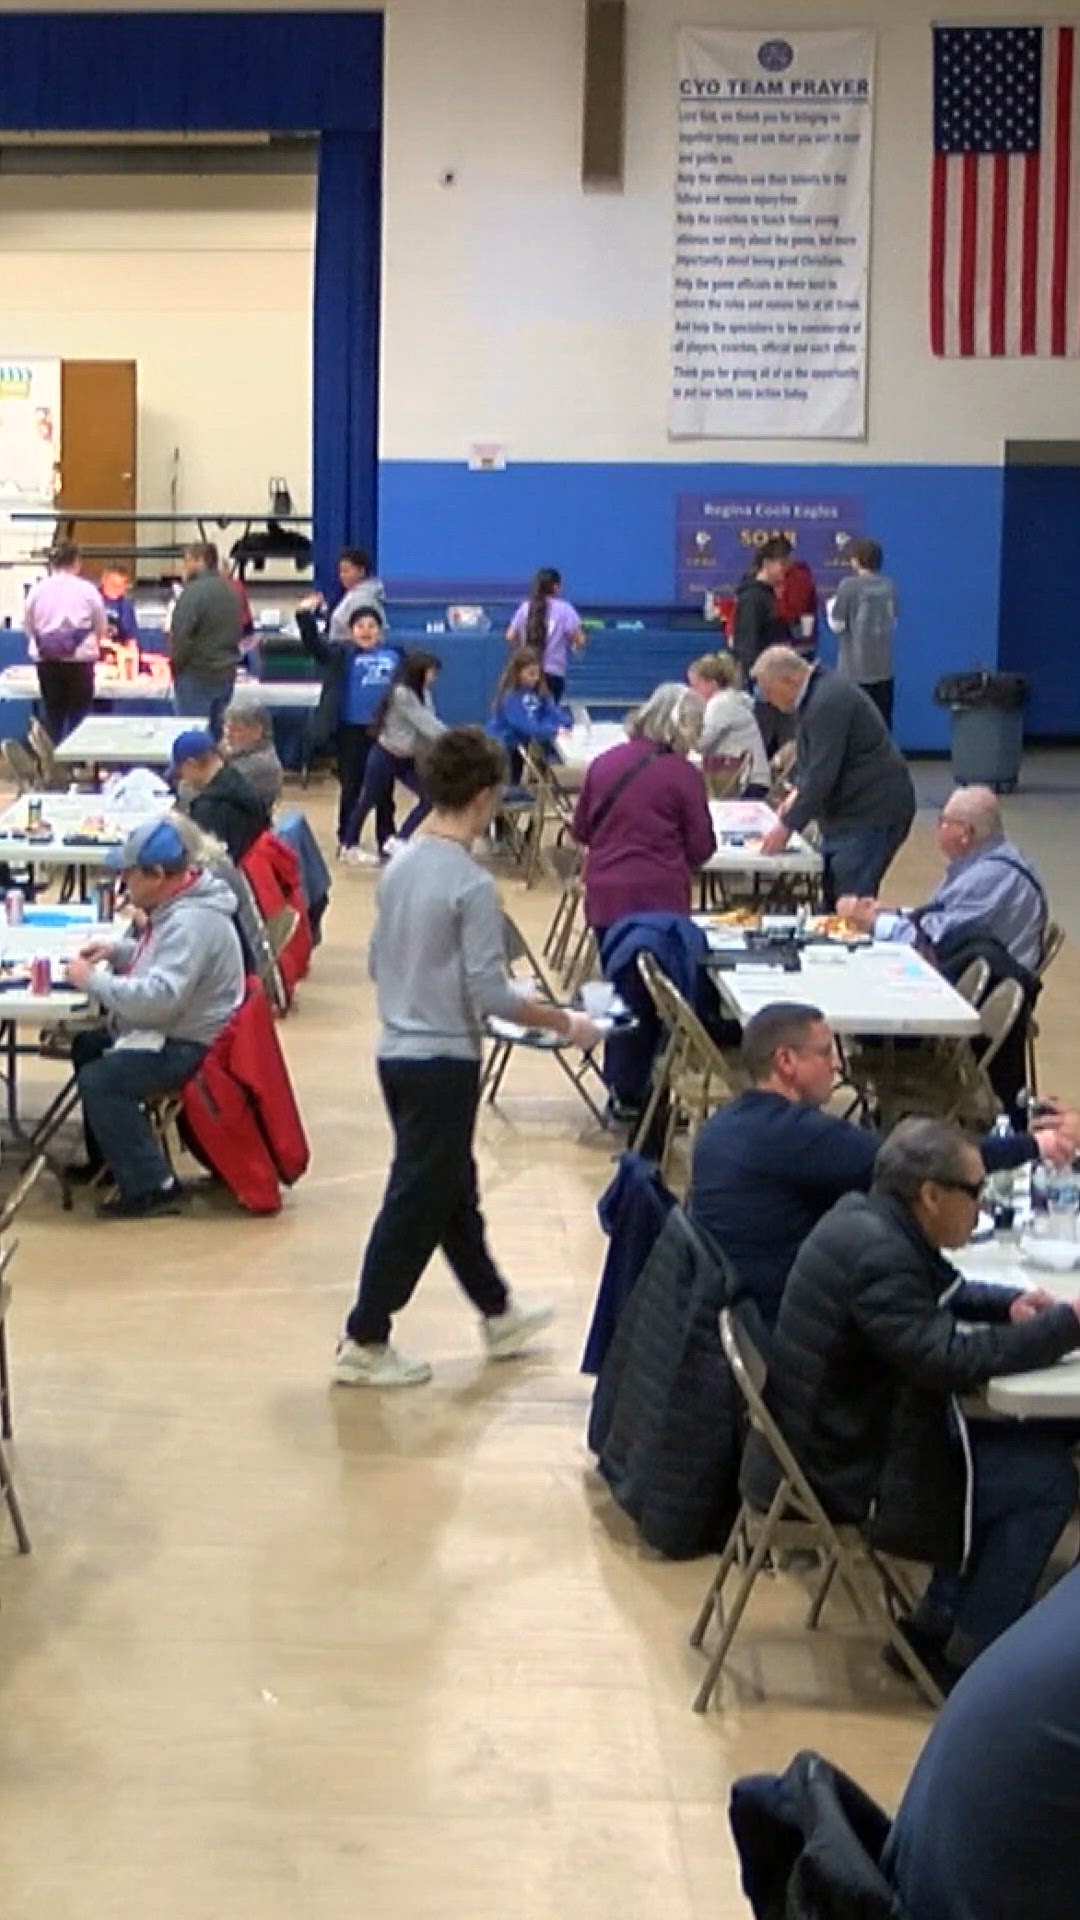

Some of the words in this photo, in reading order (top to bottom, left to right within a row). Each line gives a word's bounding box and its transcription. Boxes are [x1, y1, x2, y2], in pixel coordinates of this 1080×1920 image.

[680, 79, 721, 95] CYO
[727, 79, 783, 95] TEAM
[791, 79, 869, 95] PRAYER
[704, 503, 752, 519] Regina
